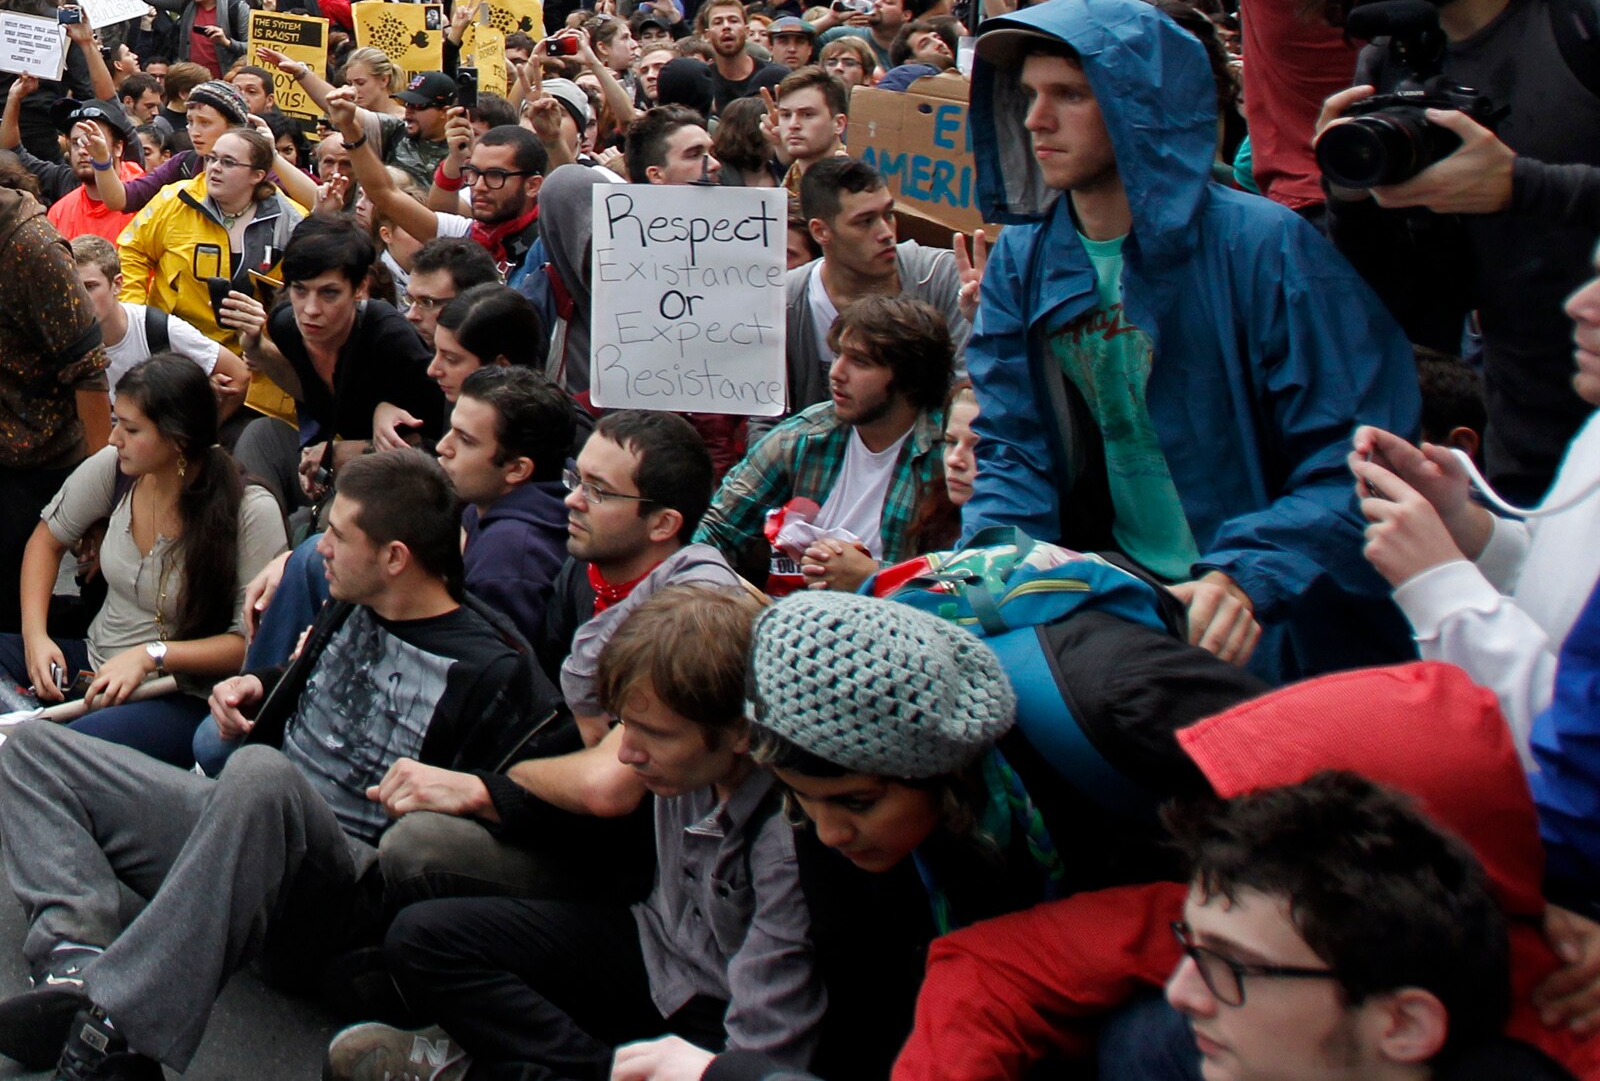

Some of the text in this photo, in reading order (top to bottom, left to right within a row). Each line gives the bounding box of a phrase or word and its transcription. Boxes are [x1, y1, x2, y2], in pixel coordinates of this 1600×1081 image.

[254, 28, 300, 42] IS RACIST!
[255, 17, 302, 31] THE SYSTEM
[605, 193, 778, 267] Respect
[596, 248, 785, 287] Existance
[615, 311, 774, 358] Expect
[594, 344, 786, 406] Resistance
